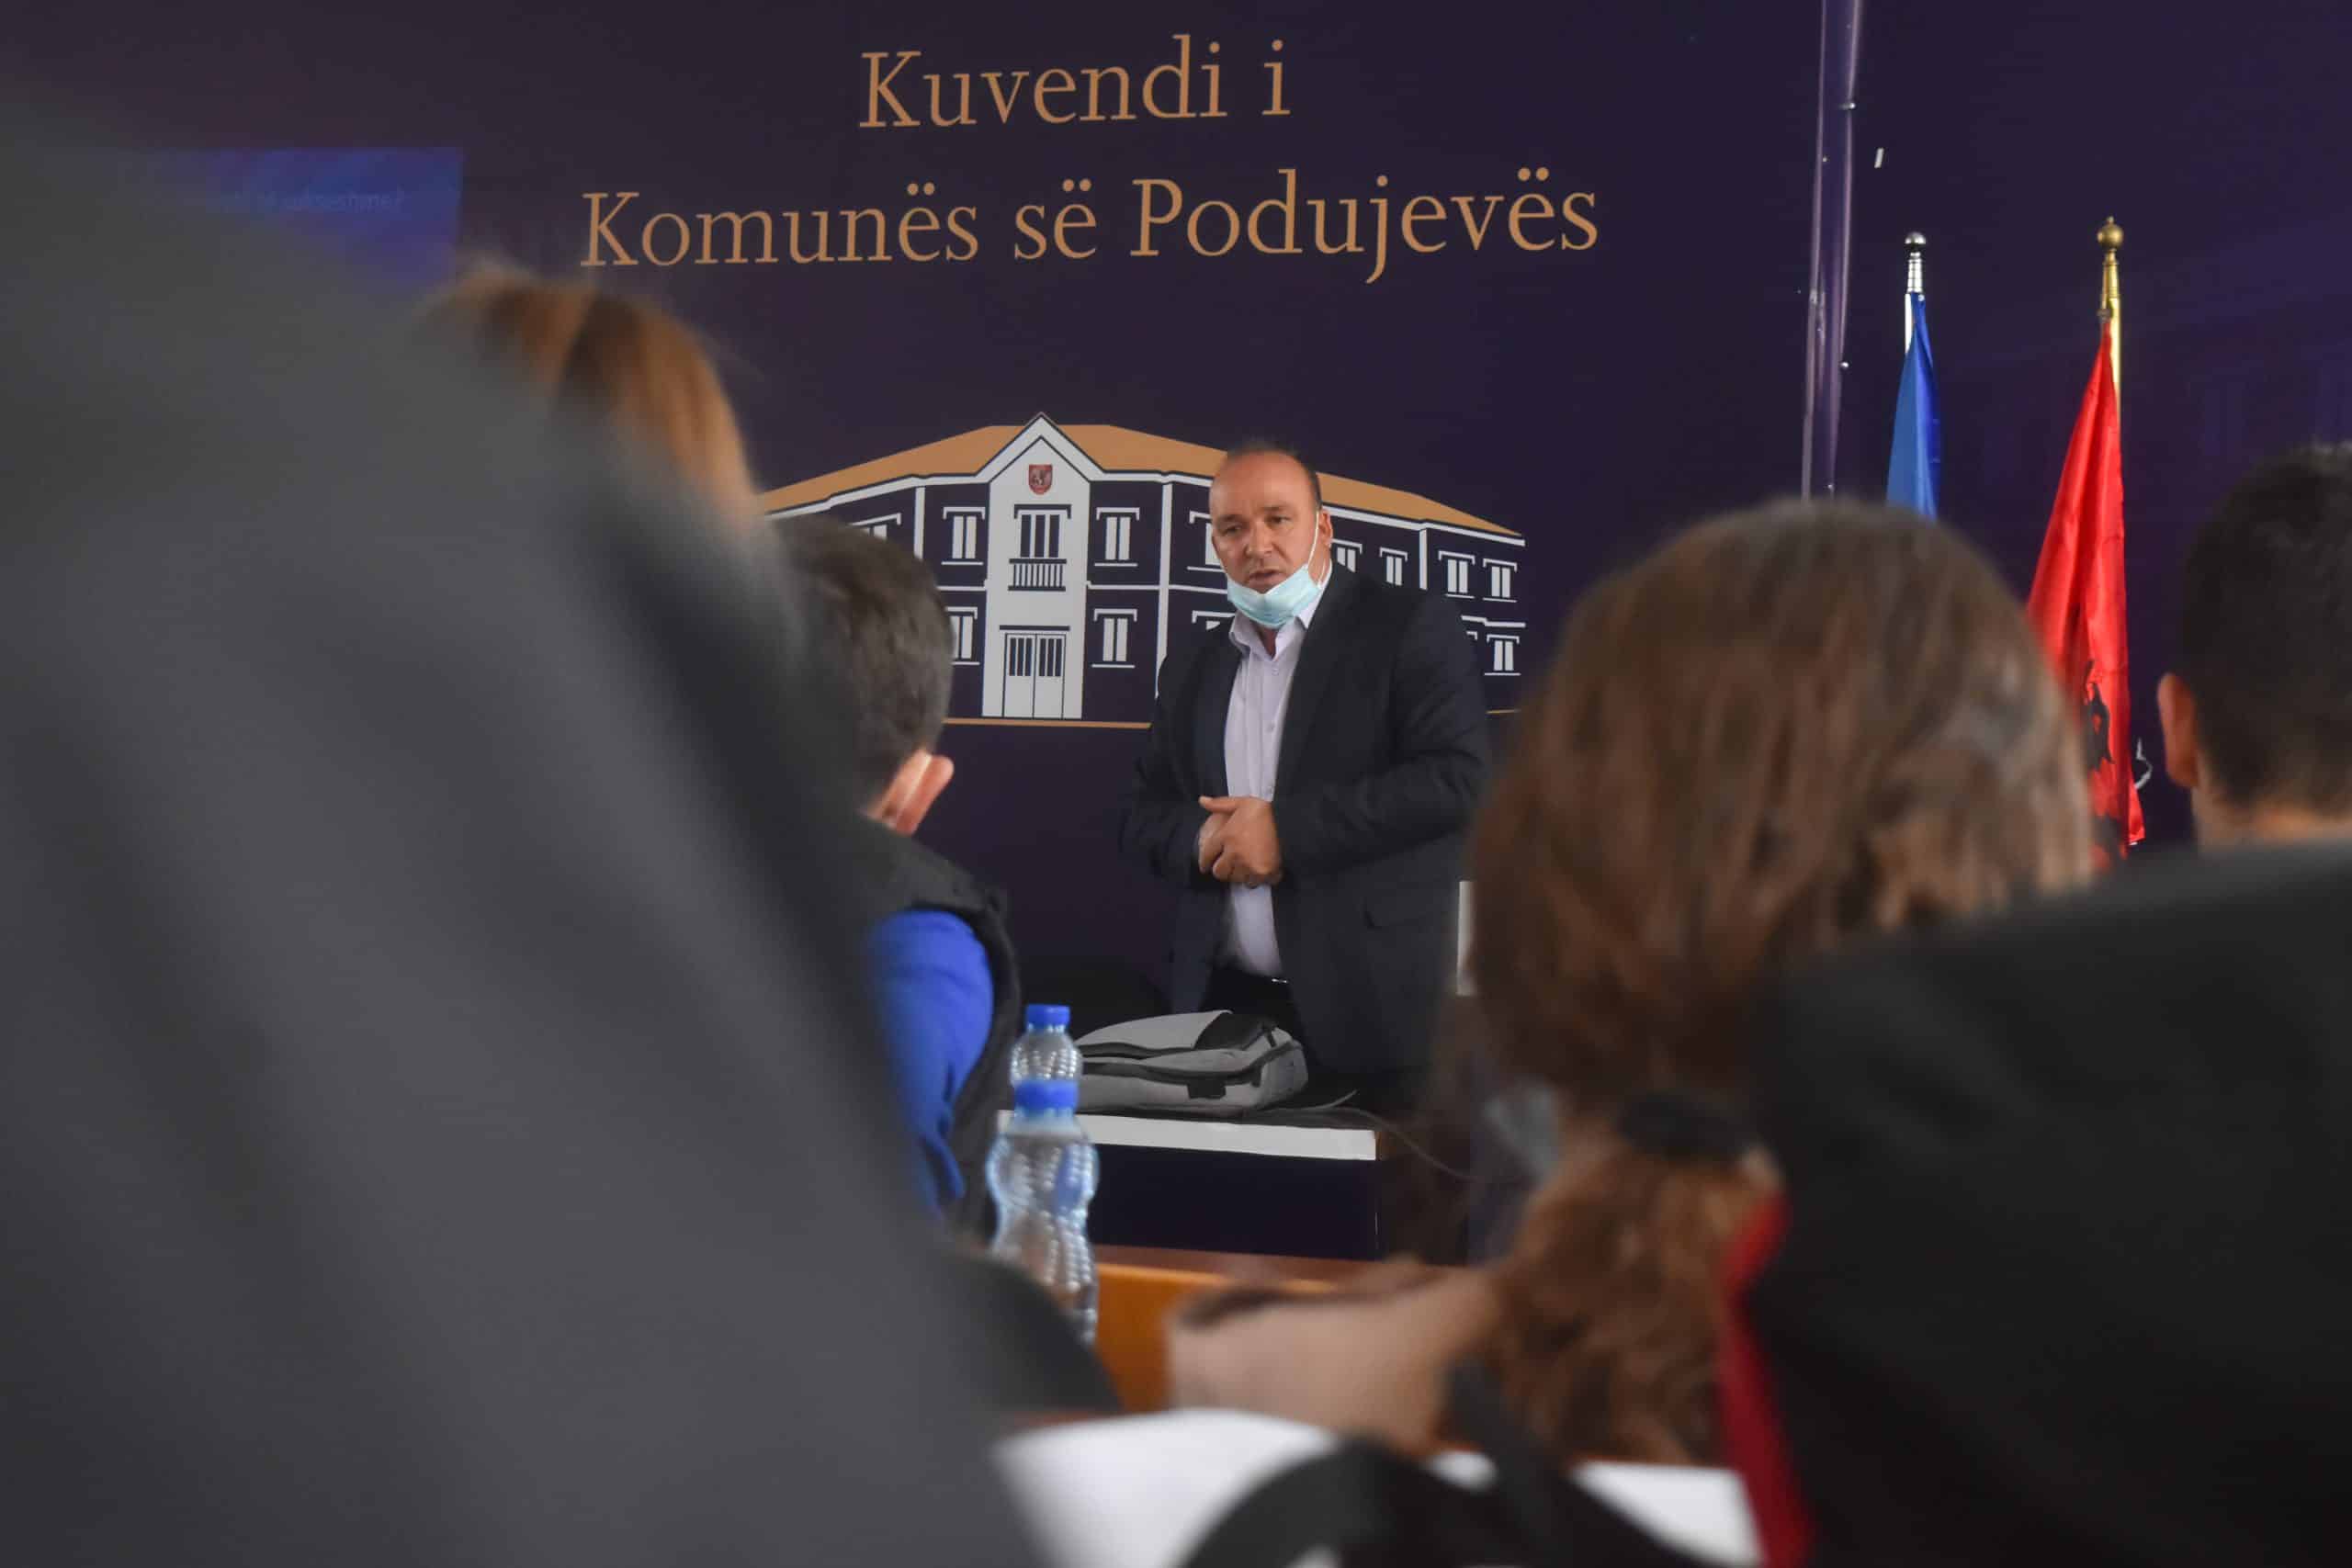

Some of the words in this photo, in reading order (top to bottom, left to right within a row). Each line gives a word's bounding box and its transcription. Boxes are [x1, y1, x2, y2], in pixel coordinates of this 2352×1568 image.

[859, 34, 1227, 128] Kuvendi
[1263, 39, 1291, 116] i
[581, 183, 978, 266] Komunës
[1014, 178, 1097, 262] së
[1130, 166, 1599, 284] Podujevës
